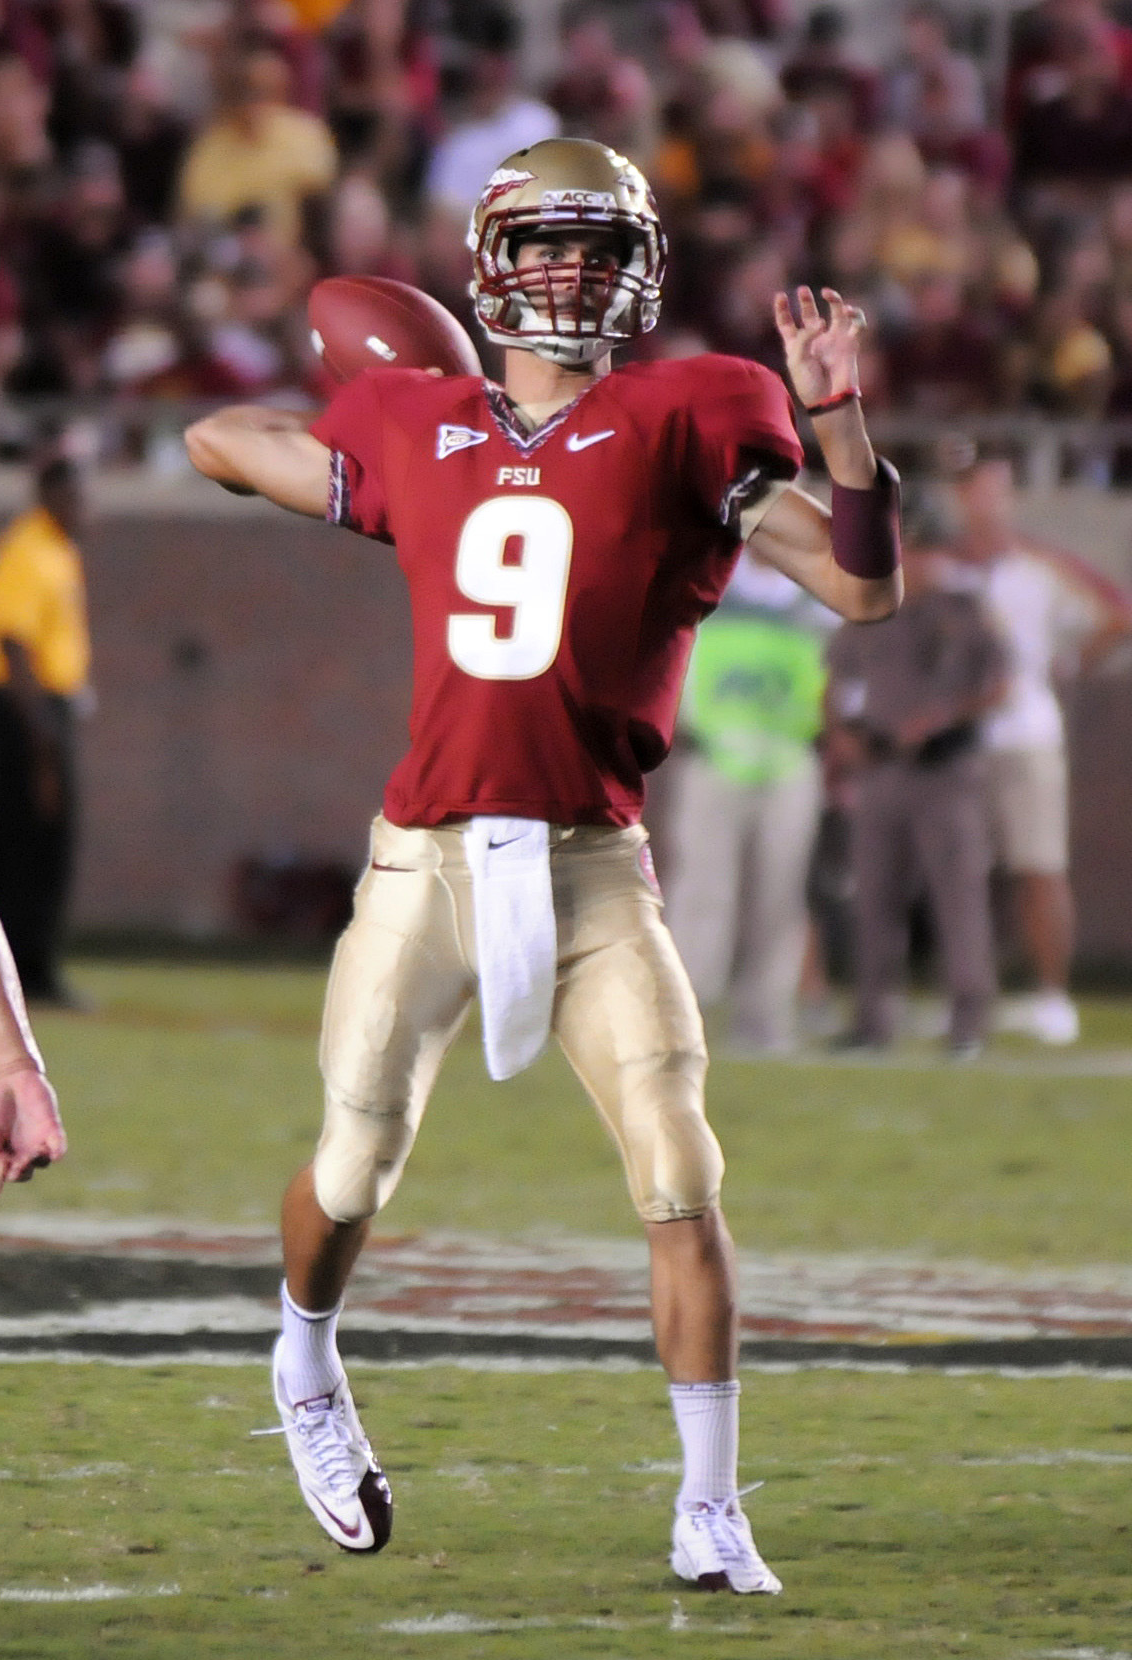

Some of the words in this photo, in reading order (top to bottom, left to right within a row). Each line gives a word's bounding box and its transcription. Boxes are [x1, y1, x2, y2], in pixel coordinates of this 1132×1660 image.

[561, 192, 594, 204] ACC
[497, 467, 541, 486] FSU
[448, 496, 573, 680] 9
